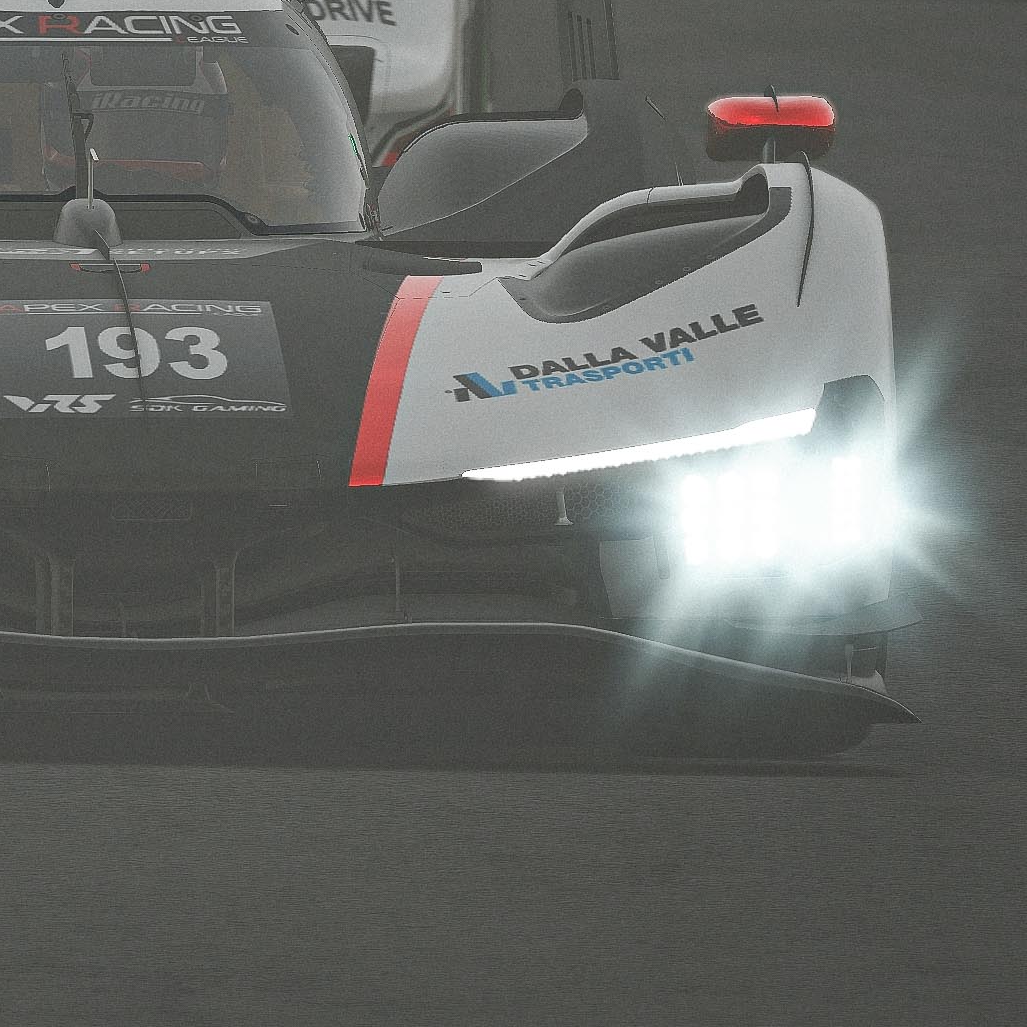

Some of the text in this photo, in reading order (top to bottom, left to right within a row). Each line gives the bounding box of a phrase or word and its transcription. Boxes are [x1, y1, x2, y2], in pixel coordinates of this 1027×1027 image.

[38, 14, 243, 35] RACING
[175, 35, 249, 44] LEAGUE
[91, 91, 206, 115] iRacing
[114, 303, 263, 314] RACING
[508, 304, 764, 379] DALLA VALLE
[45, 326, 229, 380] 193
[522, 347, 697, 392] TRASPORTI
[3, 393, 117, 414] VRS
[193, 404, 287, 413] GAMING
